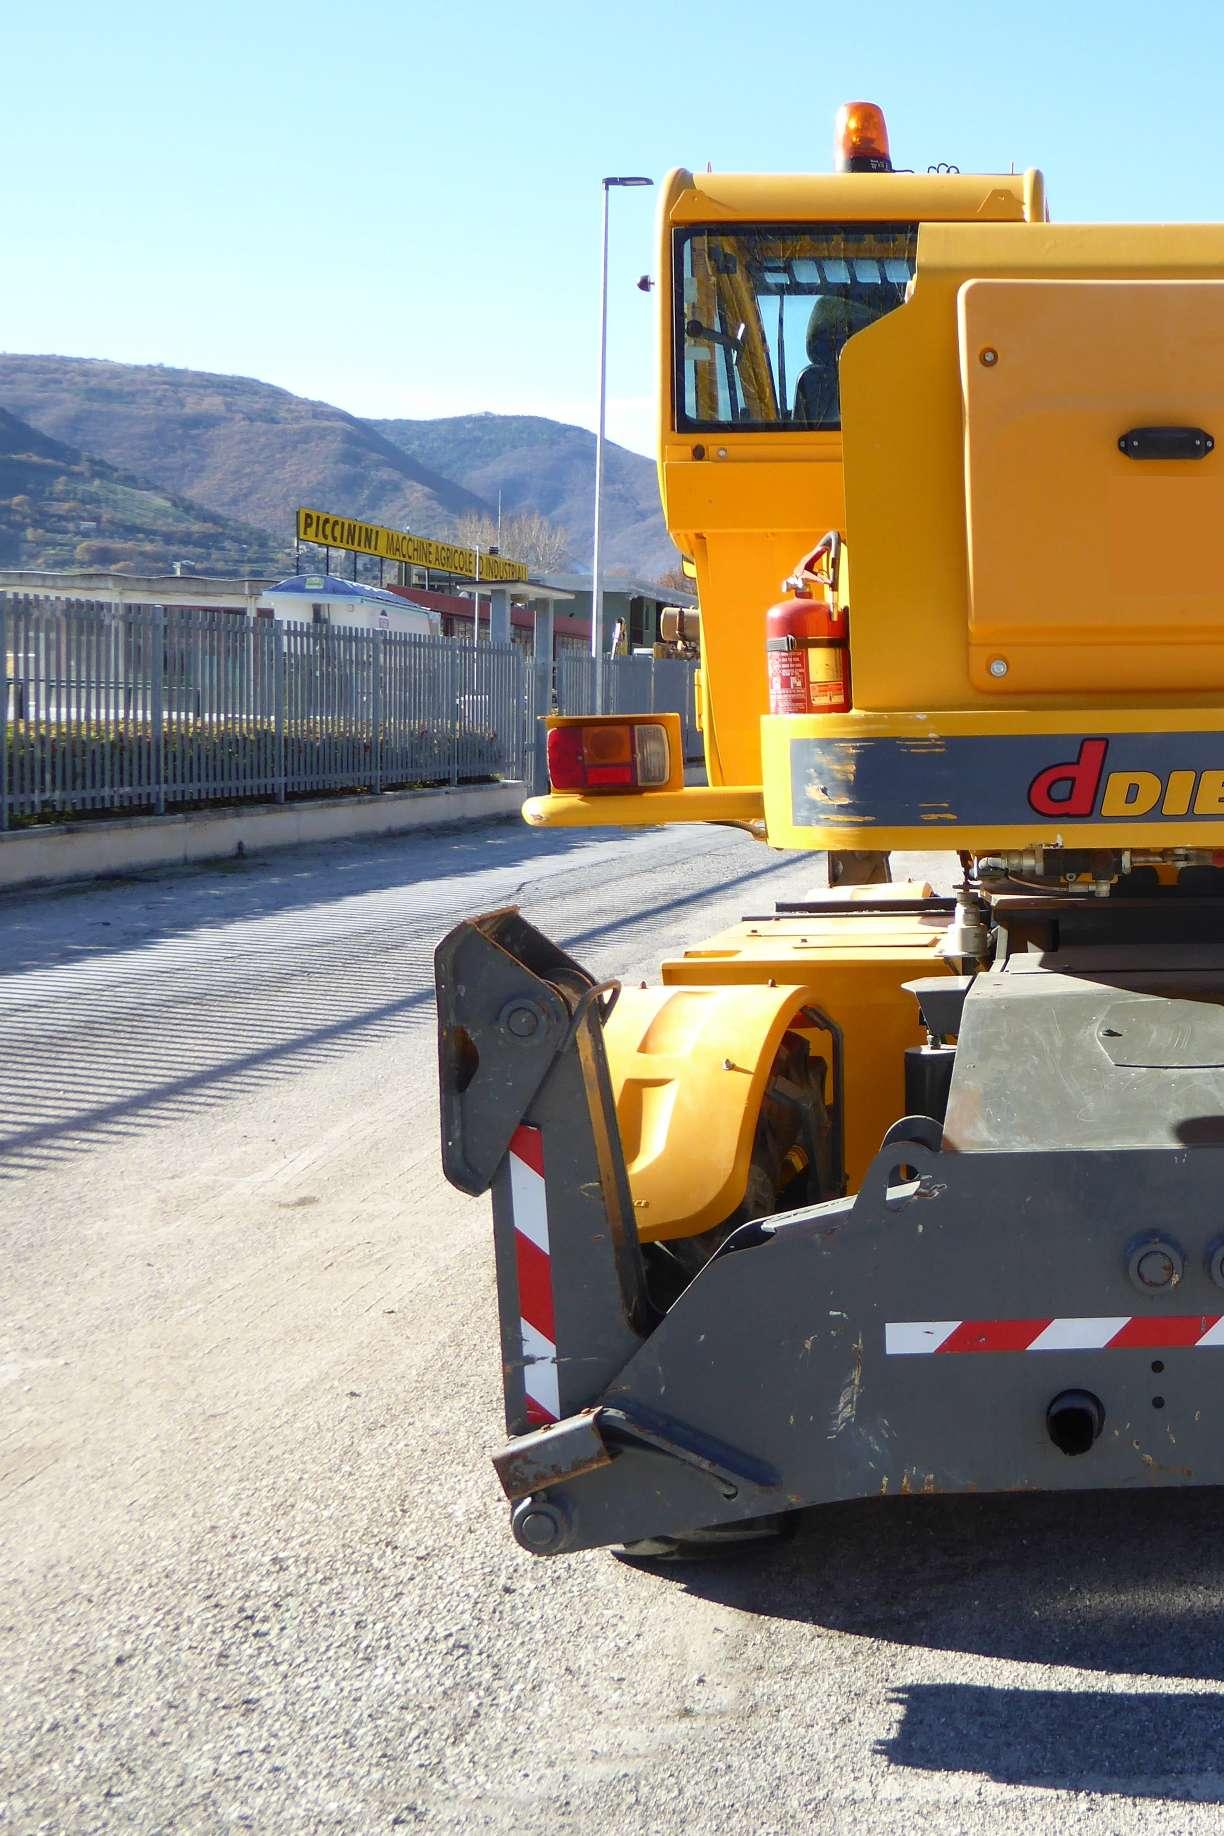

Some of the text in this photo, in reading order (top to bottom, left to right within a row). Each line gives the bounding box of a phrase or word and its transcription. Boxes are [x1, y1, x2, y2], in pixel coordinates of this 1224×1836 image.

[304, 512, 379, 551] PICCININI
[386, 531, 433, 564] MACCHINE
[434, 545, 473, 574] AGRICOLE
